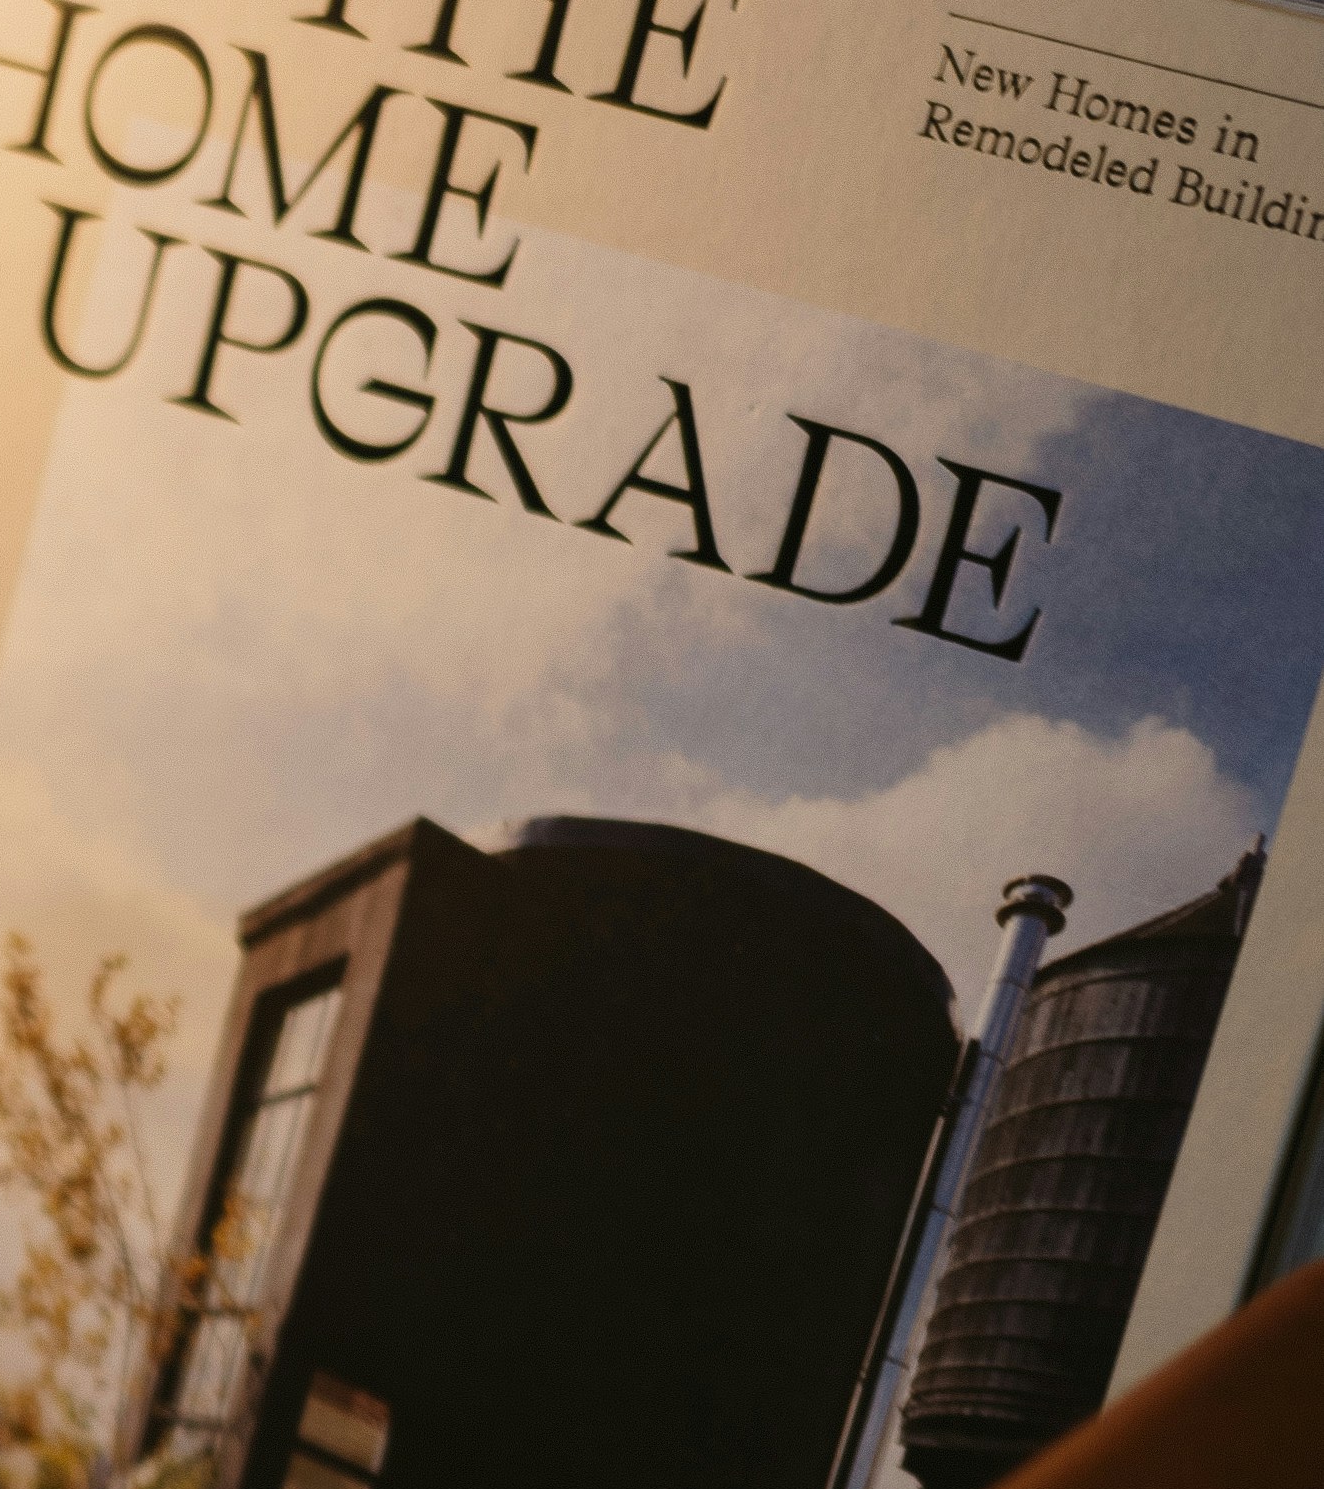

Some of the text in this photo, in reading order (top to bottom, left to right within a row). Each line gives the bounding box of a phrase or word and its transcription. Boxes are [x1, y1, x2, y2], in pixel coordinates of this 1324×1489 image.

[917, 99, 1160, 196] Remodeled
[933, 43, 1260, 164] New Homes in
[37, 198, 1063, 663] UPGRADE
